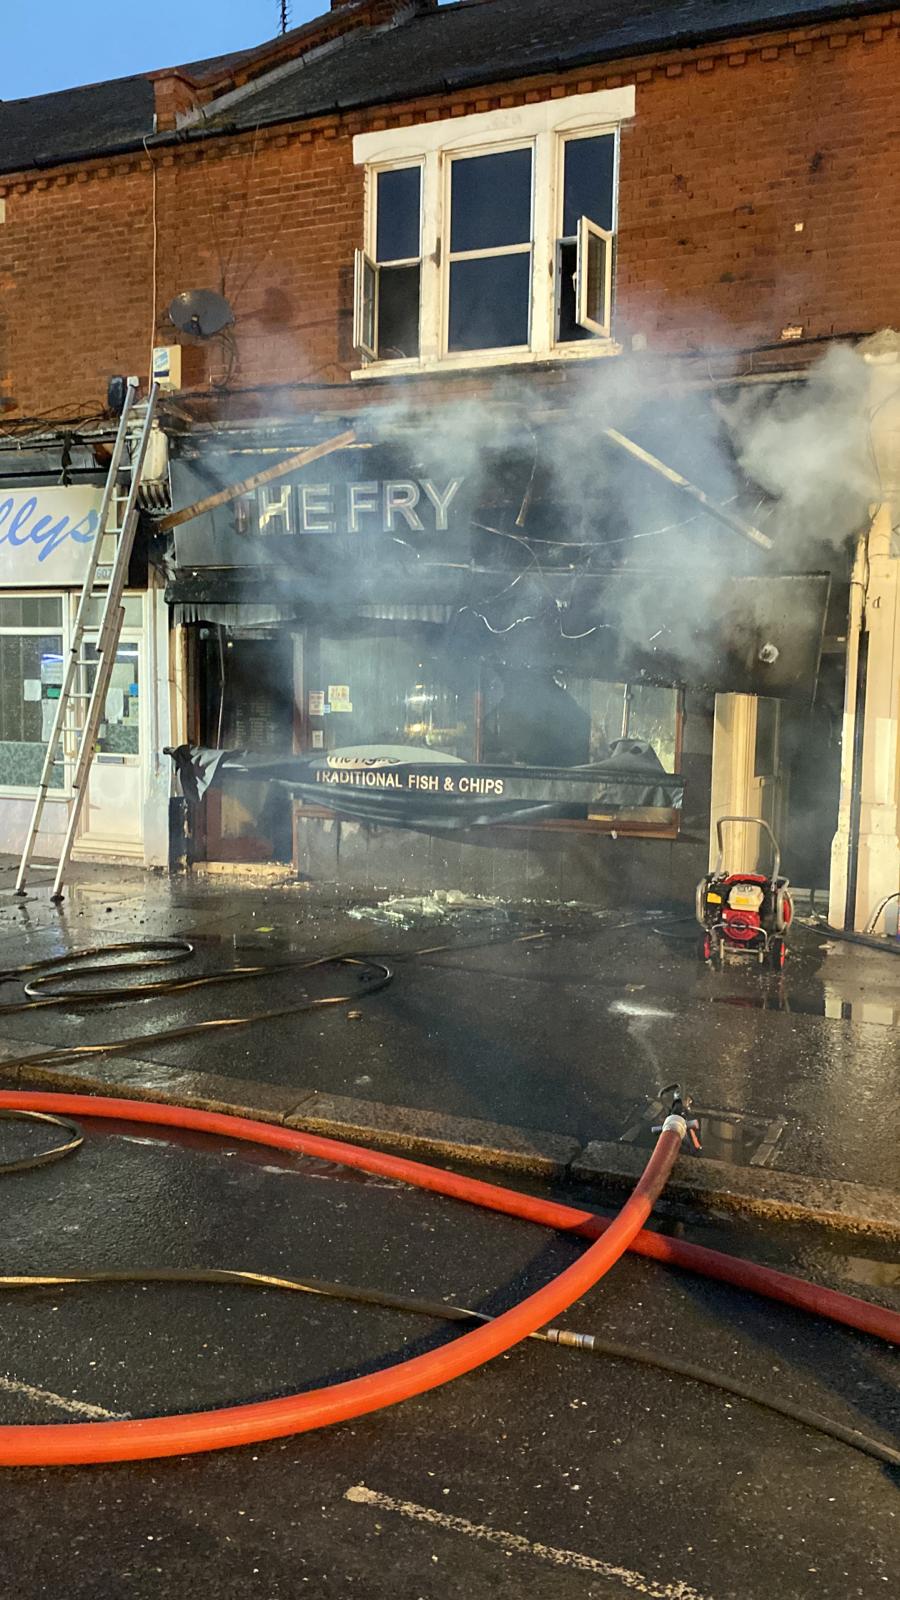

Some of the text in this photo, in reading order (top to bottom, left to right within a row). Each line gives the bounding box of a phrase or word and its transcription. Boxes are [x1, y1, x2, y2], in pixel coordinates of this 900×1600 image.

[347, 477, 464, 533] FRY
[316, 770, 504, 794] TRADITIONAL FISH & CHIPS
